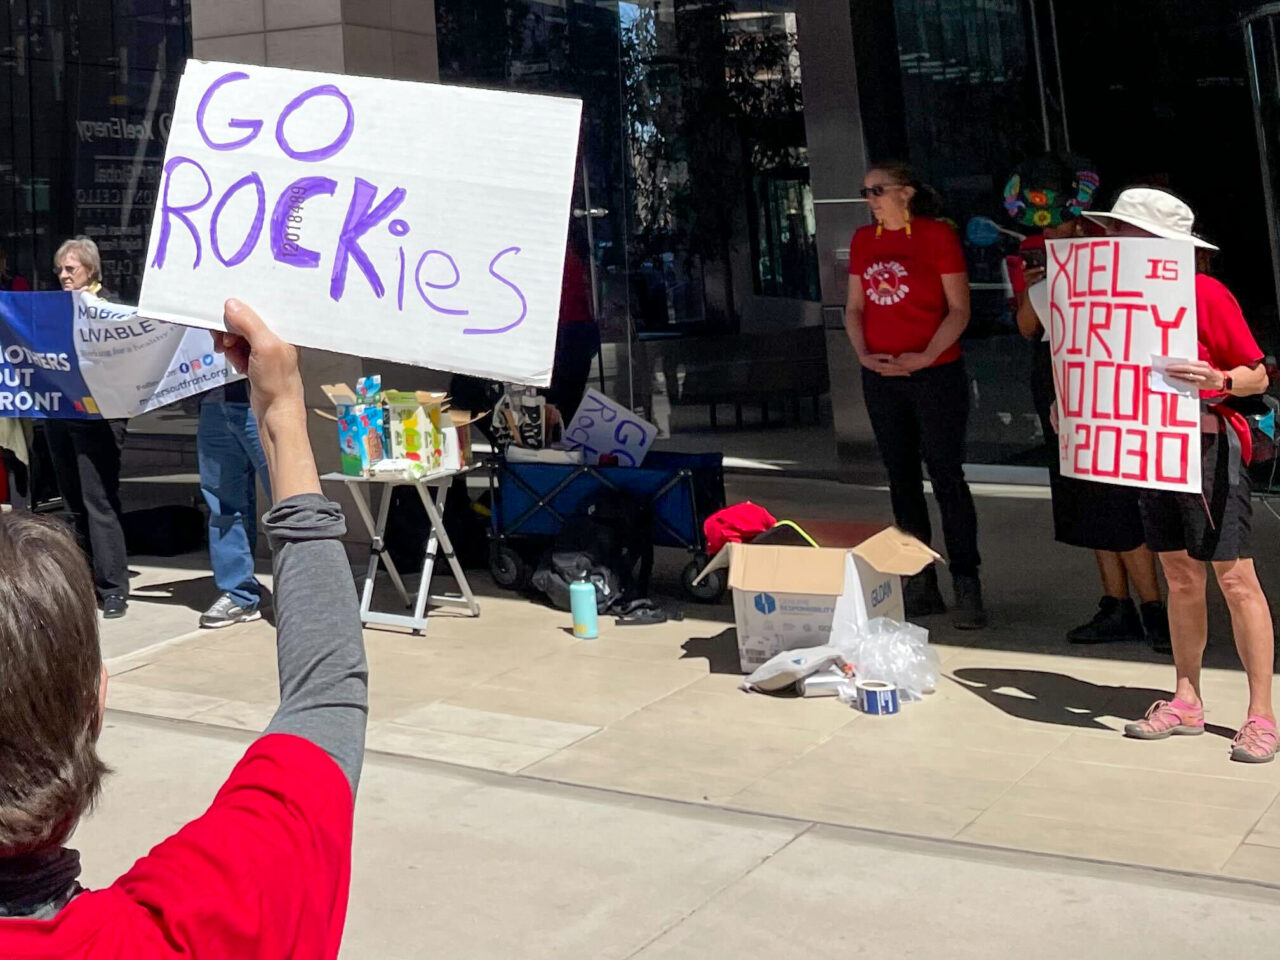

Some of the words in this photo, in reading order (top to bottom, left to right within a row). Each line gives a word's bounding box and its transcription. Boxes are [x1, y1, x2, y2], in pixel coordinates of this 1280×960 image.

[196, 71, 355, 162] GO
[1050, 240, 1144, 302] XCEL
[1145, 258, 1179, 281] IS
[80, 319, 157, 343] LIVABLE
[1050, 301, 1188, 362] DIRTY
[1053, 360, 1085, 419] NO
[1091, 360, 1198, 428] COAL
[1073, 424, 1190, 485] 2030
